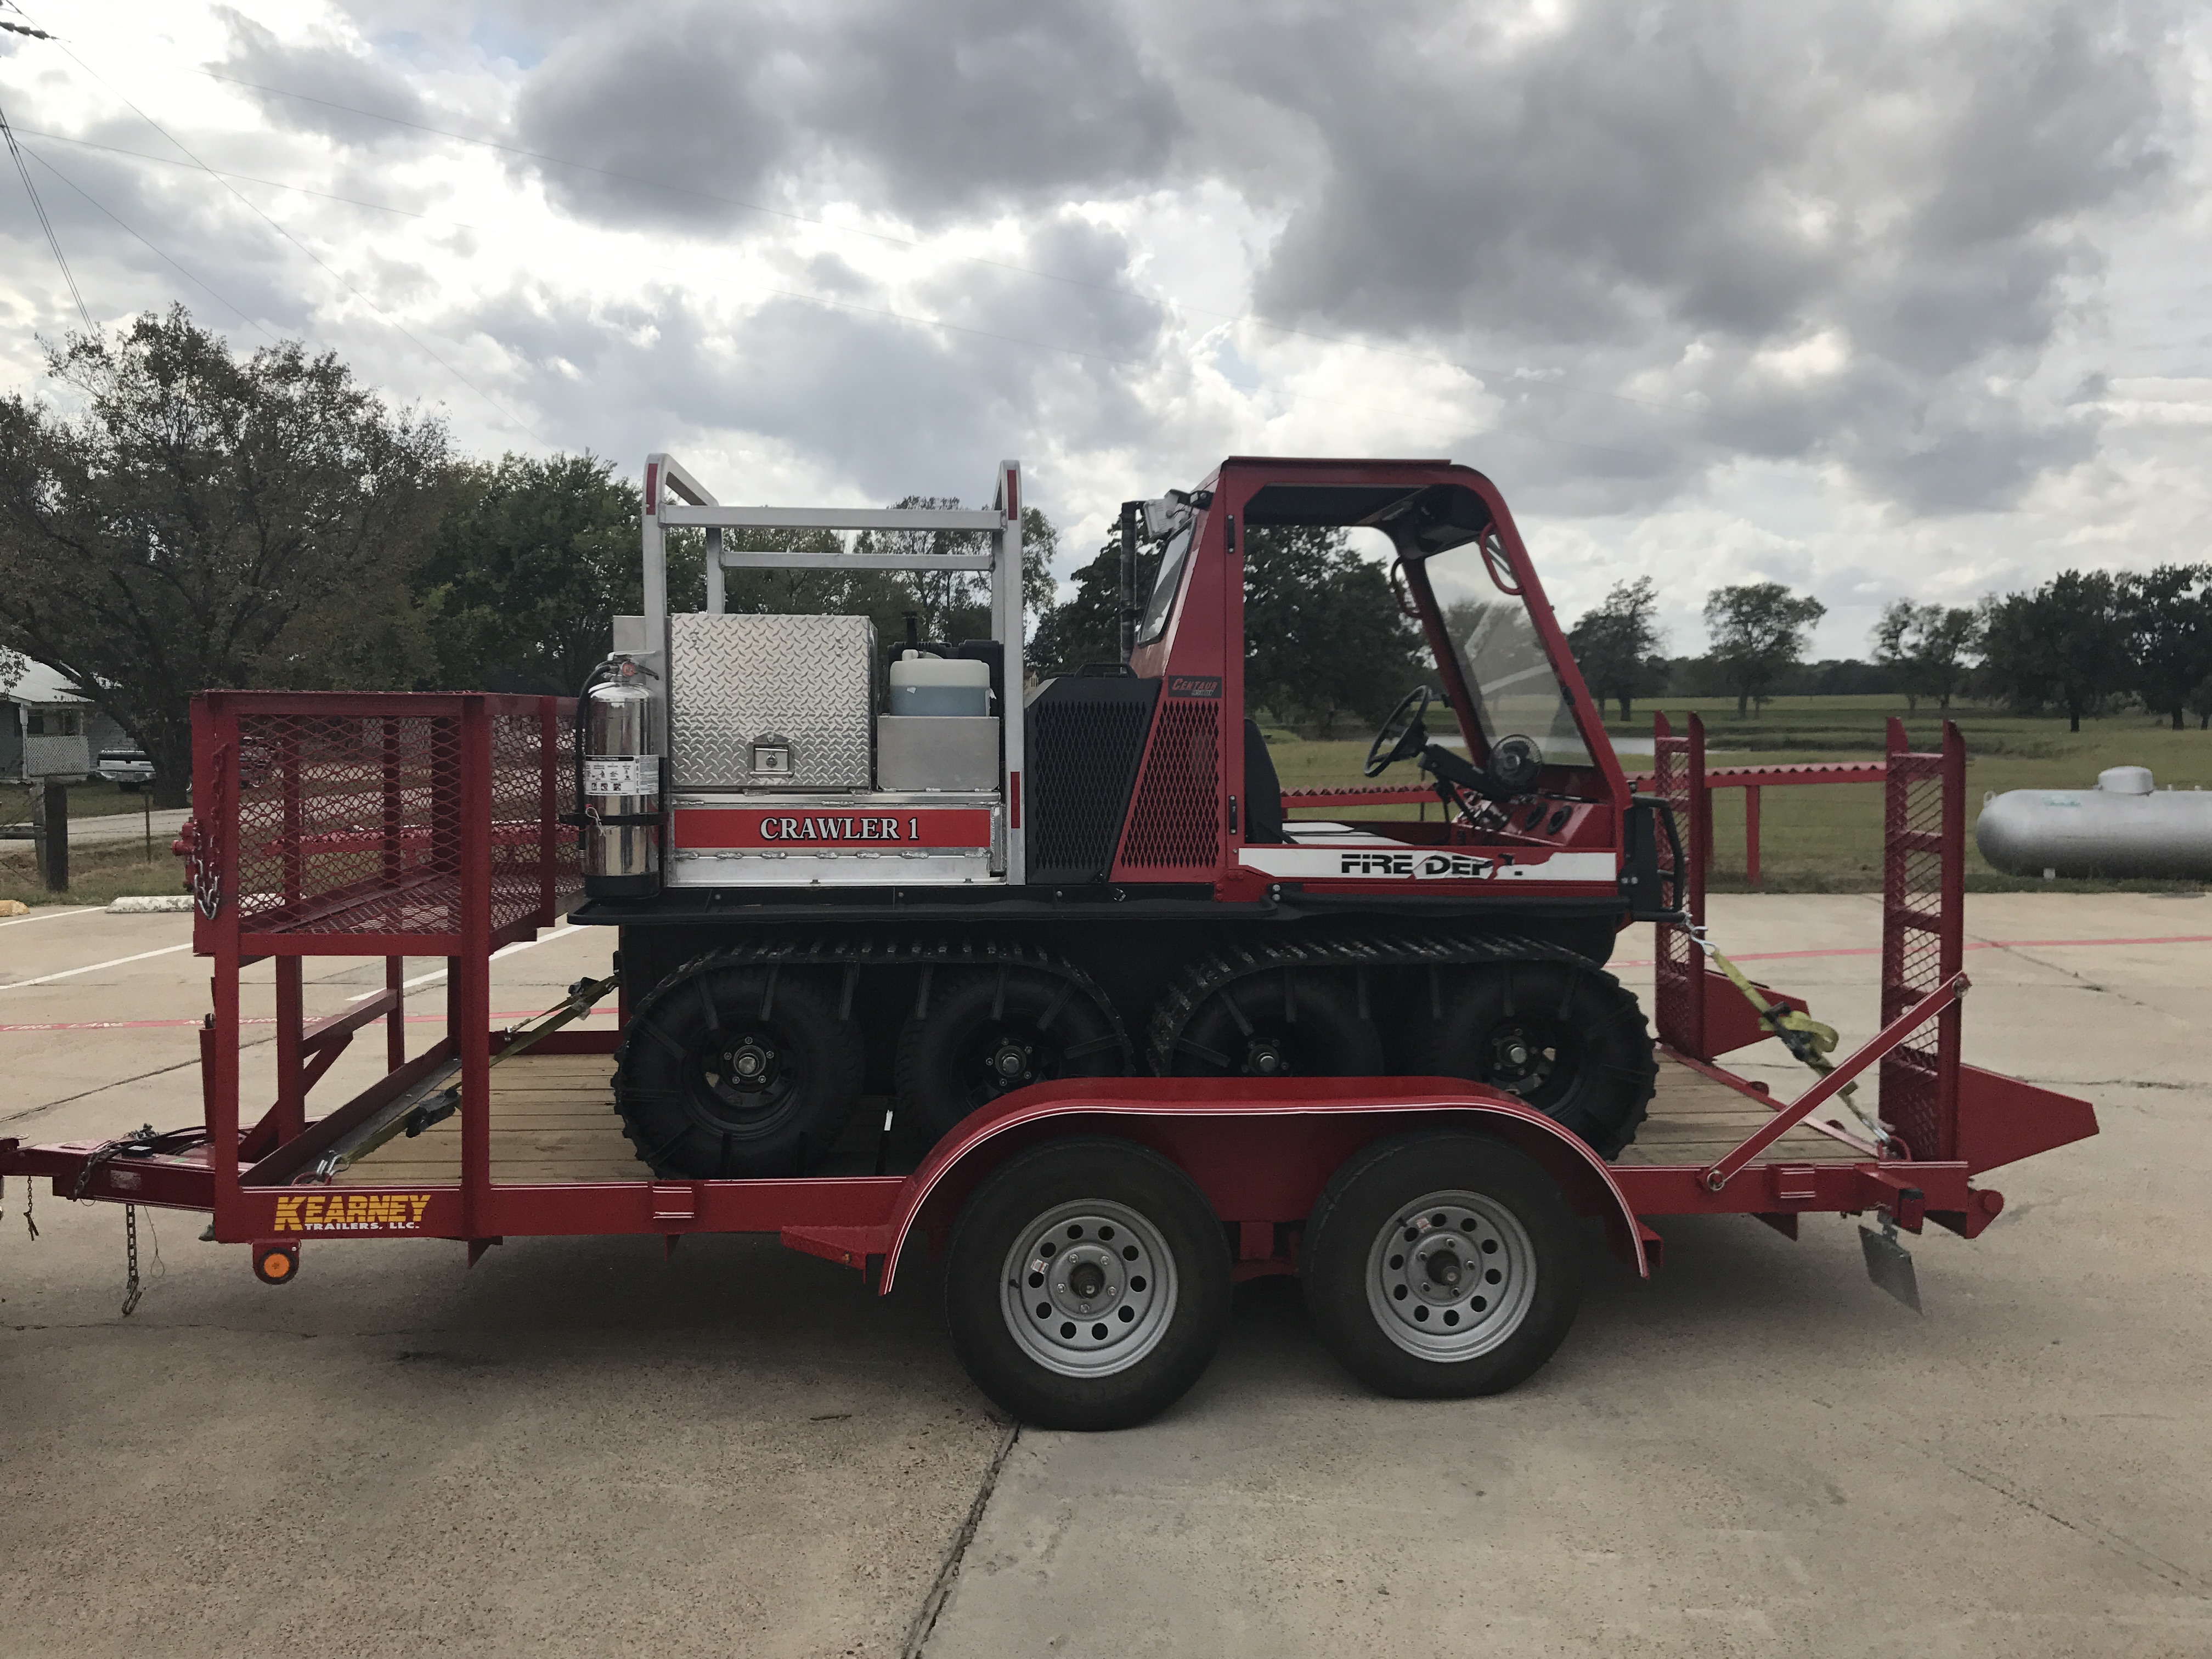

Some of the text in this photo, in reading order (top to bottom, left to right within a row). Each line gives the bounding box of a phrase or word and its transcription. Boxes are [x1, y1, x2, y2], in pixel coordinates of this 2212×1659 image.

[1172, 678, 1218, 690] CENTAUR
[760, 817, 920, 841] CRAWLER 1
[1341, 854, 1413, 874] FIRE
[274, 1195, 431, 1231] KEARNEY
[304, 1221, 420, 1231] TRAILERS, LLC.
